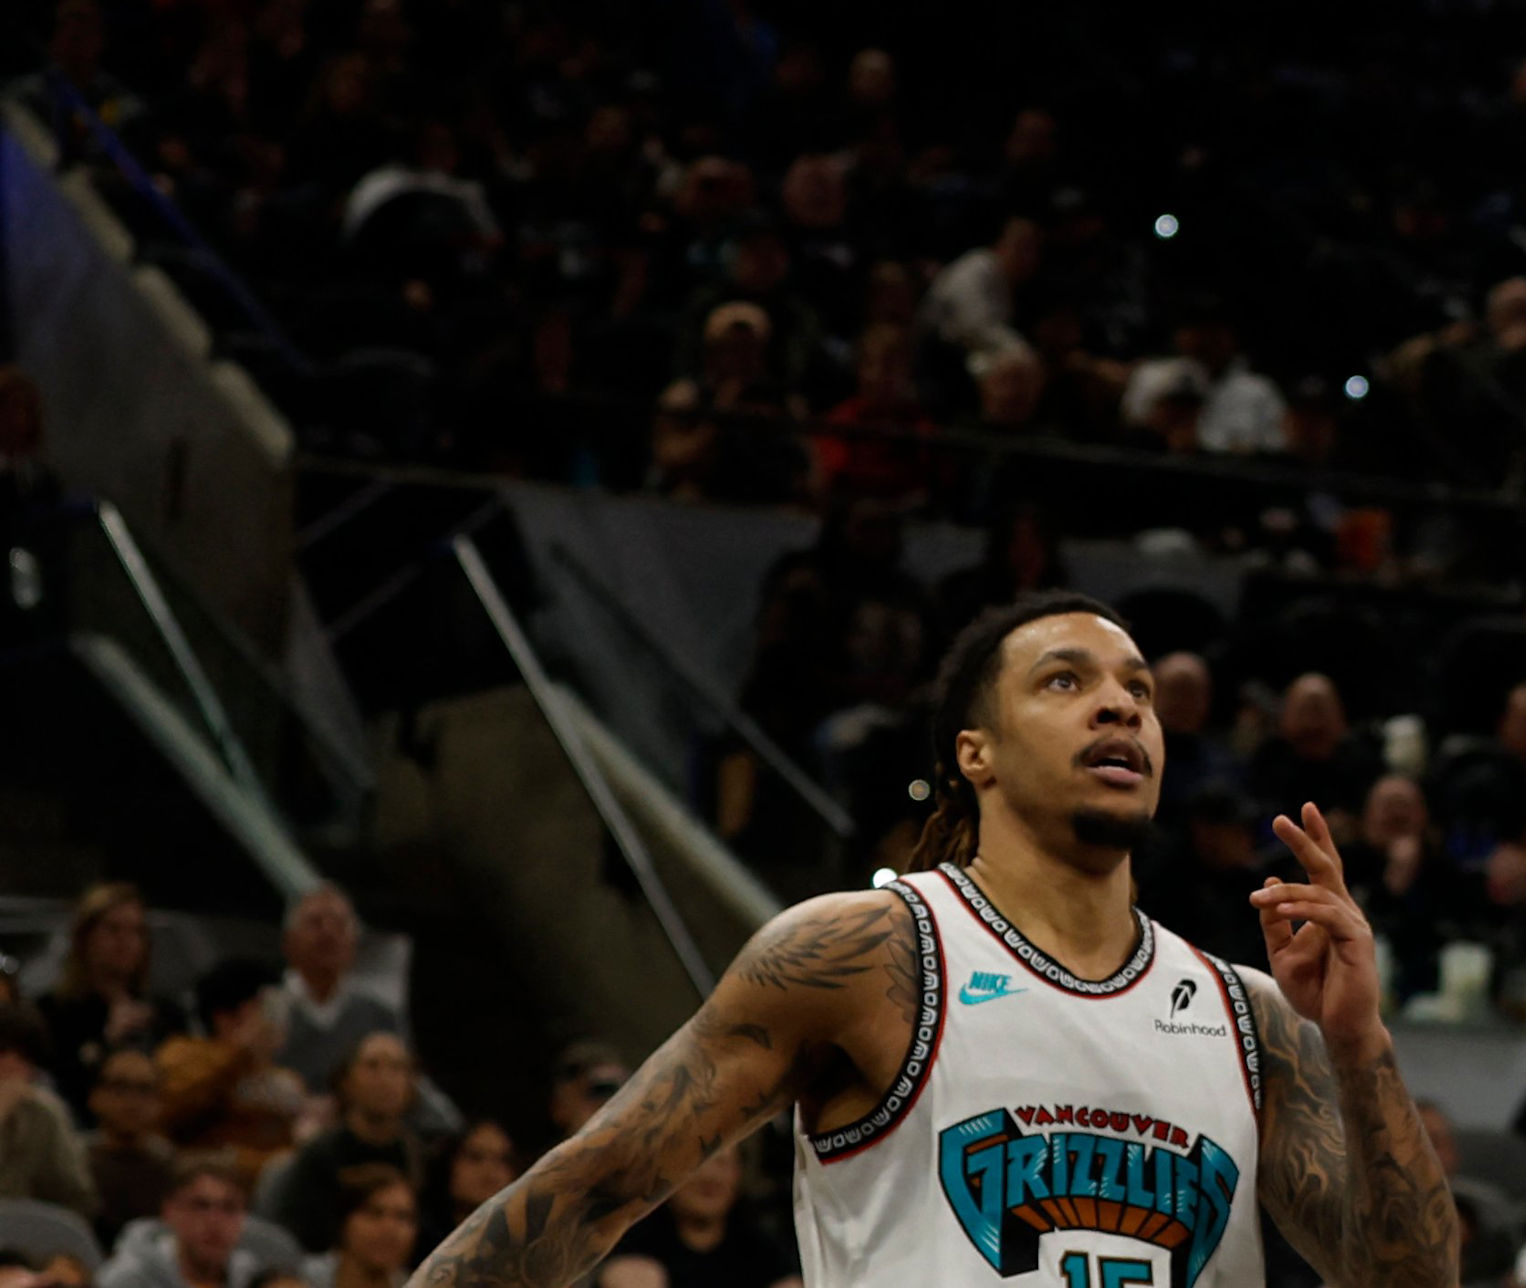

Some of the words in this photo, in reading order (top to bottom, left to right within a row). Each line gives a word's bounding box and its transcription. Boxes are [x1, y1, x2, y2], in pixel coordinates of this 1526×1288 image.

[968, 971, 1013, 993] NIKE
[1154, 1018, 1227, 1038] Robinhood
[1014, 1104, 1190, 1149] VANCOUVER
[938, 1107, 1240, 1288] GRIZZLIES
